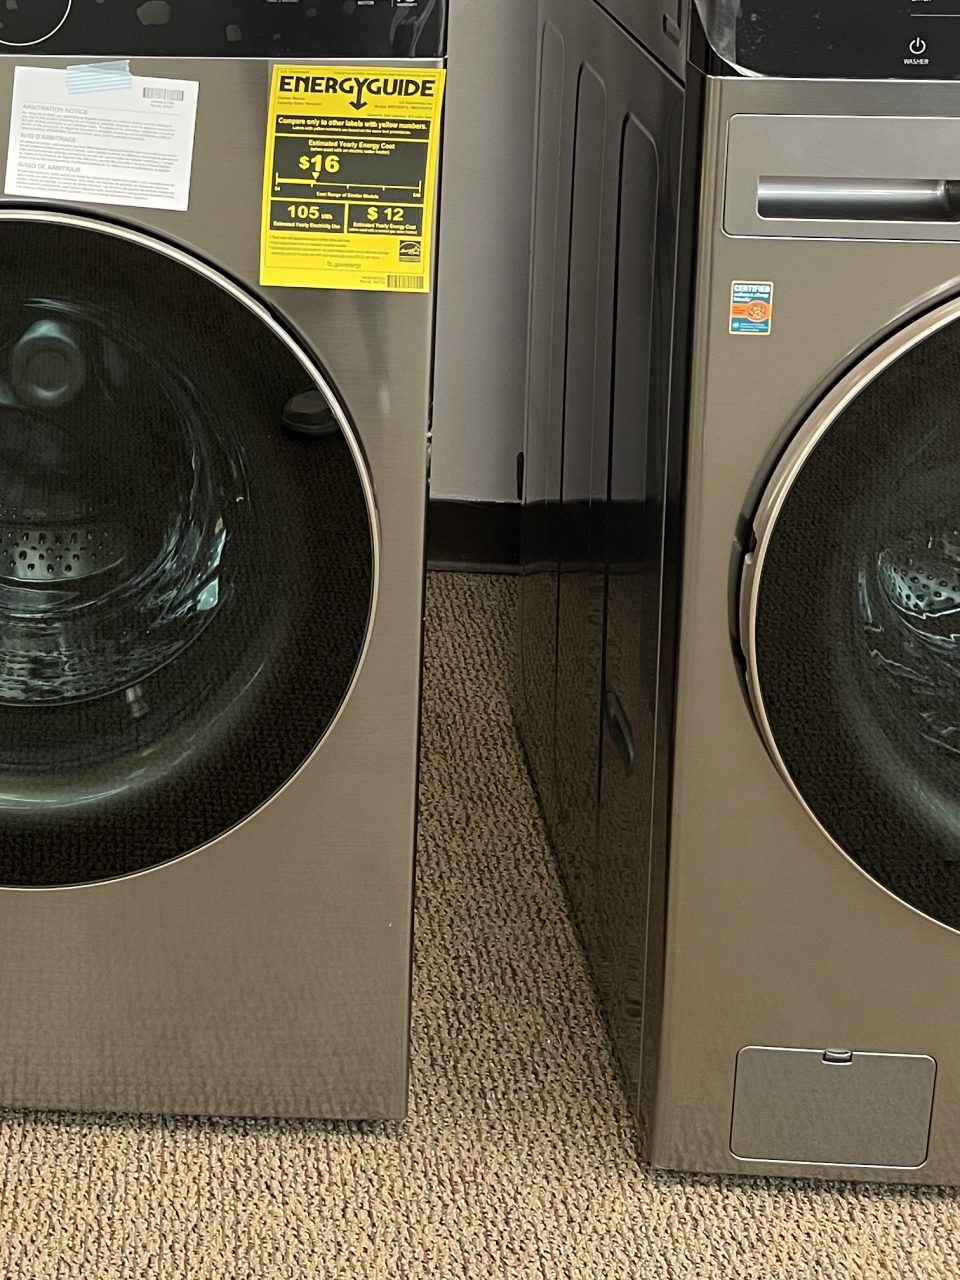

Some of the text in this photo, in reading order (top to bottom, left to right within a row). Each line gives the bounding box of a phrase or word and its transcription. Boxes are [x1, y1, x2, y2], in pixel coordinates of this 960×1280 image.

[279, 75, 436, 98] ENERGYGUIDE
[278, 116, 306, 126] Compare
[306, 118, 320, 127] only
[345, 119, 363, 127] labels
[378, 121, 398, 129] yellow
[308, 139, 338, 147] Estimated
[339, 140, 358, 149] Yearly
[358, 141, 380, 150] Energy
[298, 154, 341, 173] $16
[287, 204, 320, 220] 105
[367, 206, 404, 221] $ 12
[733, 284, 771, 293] CERTIFIED
